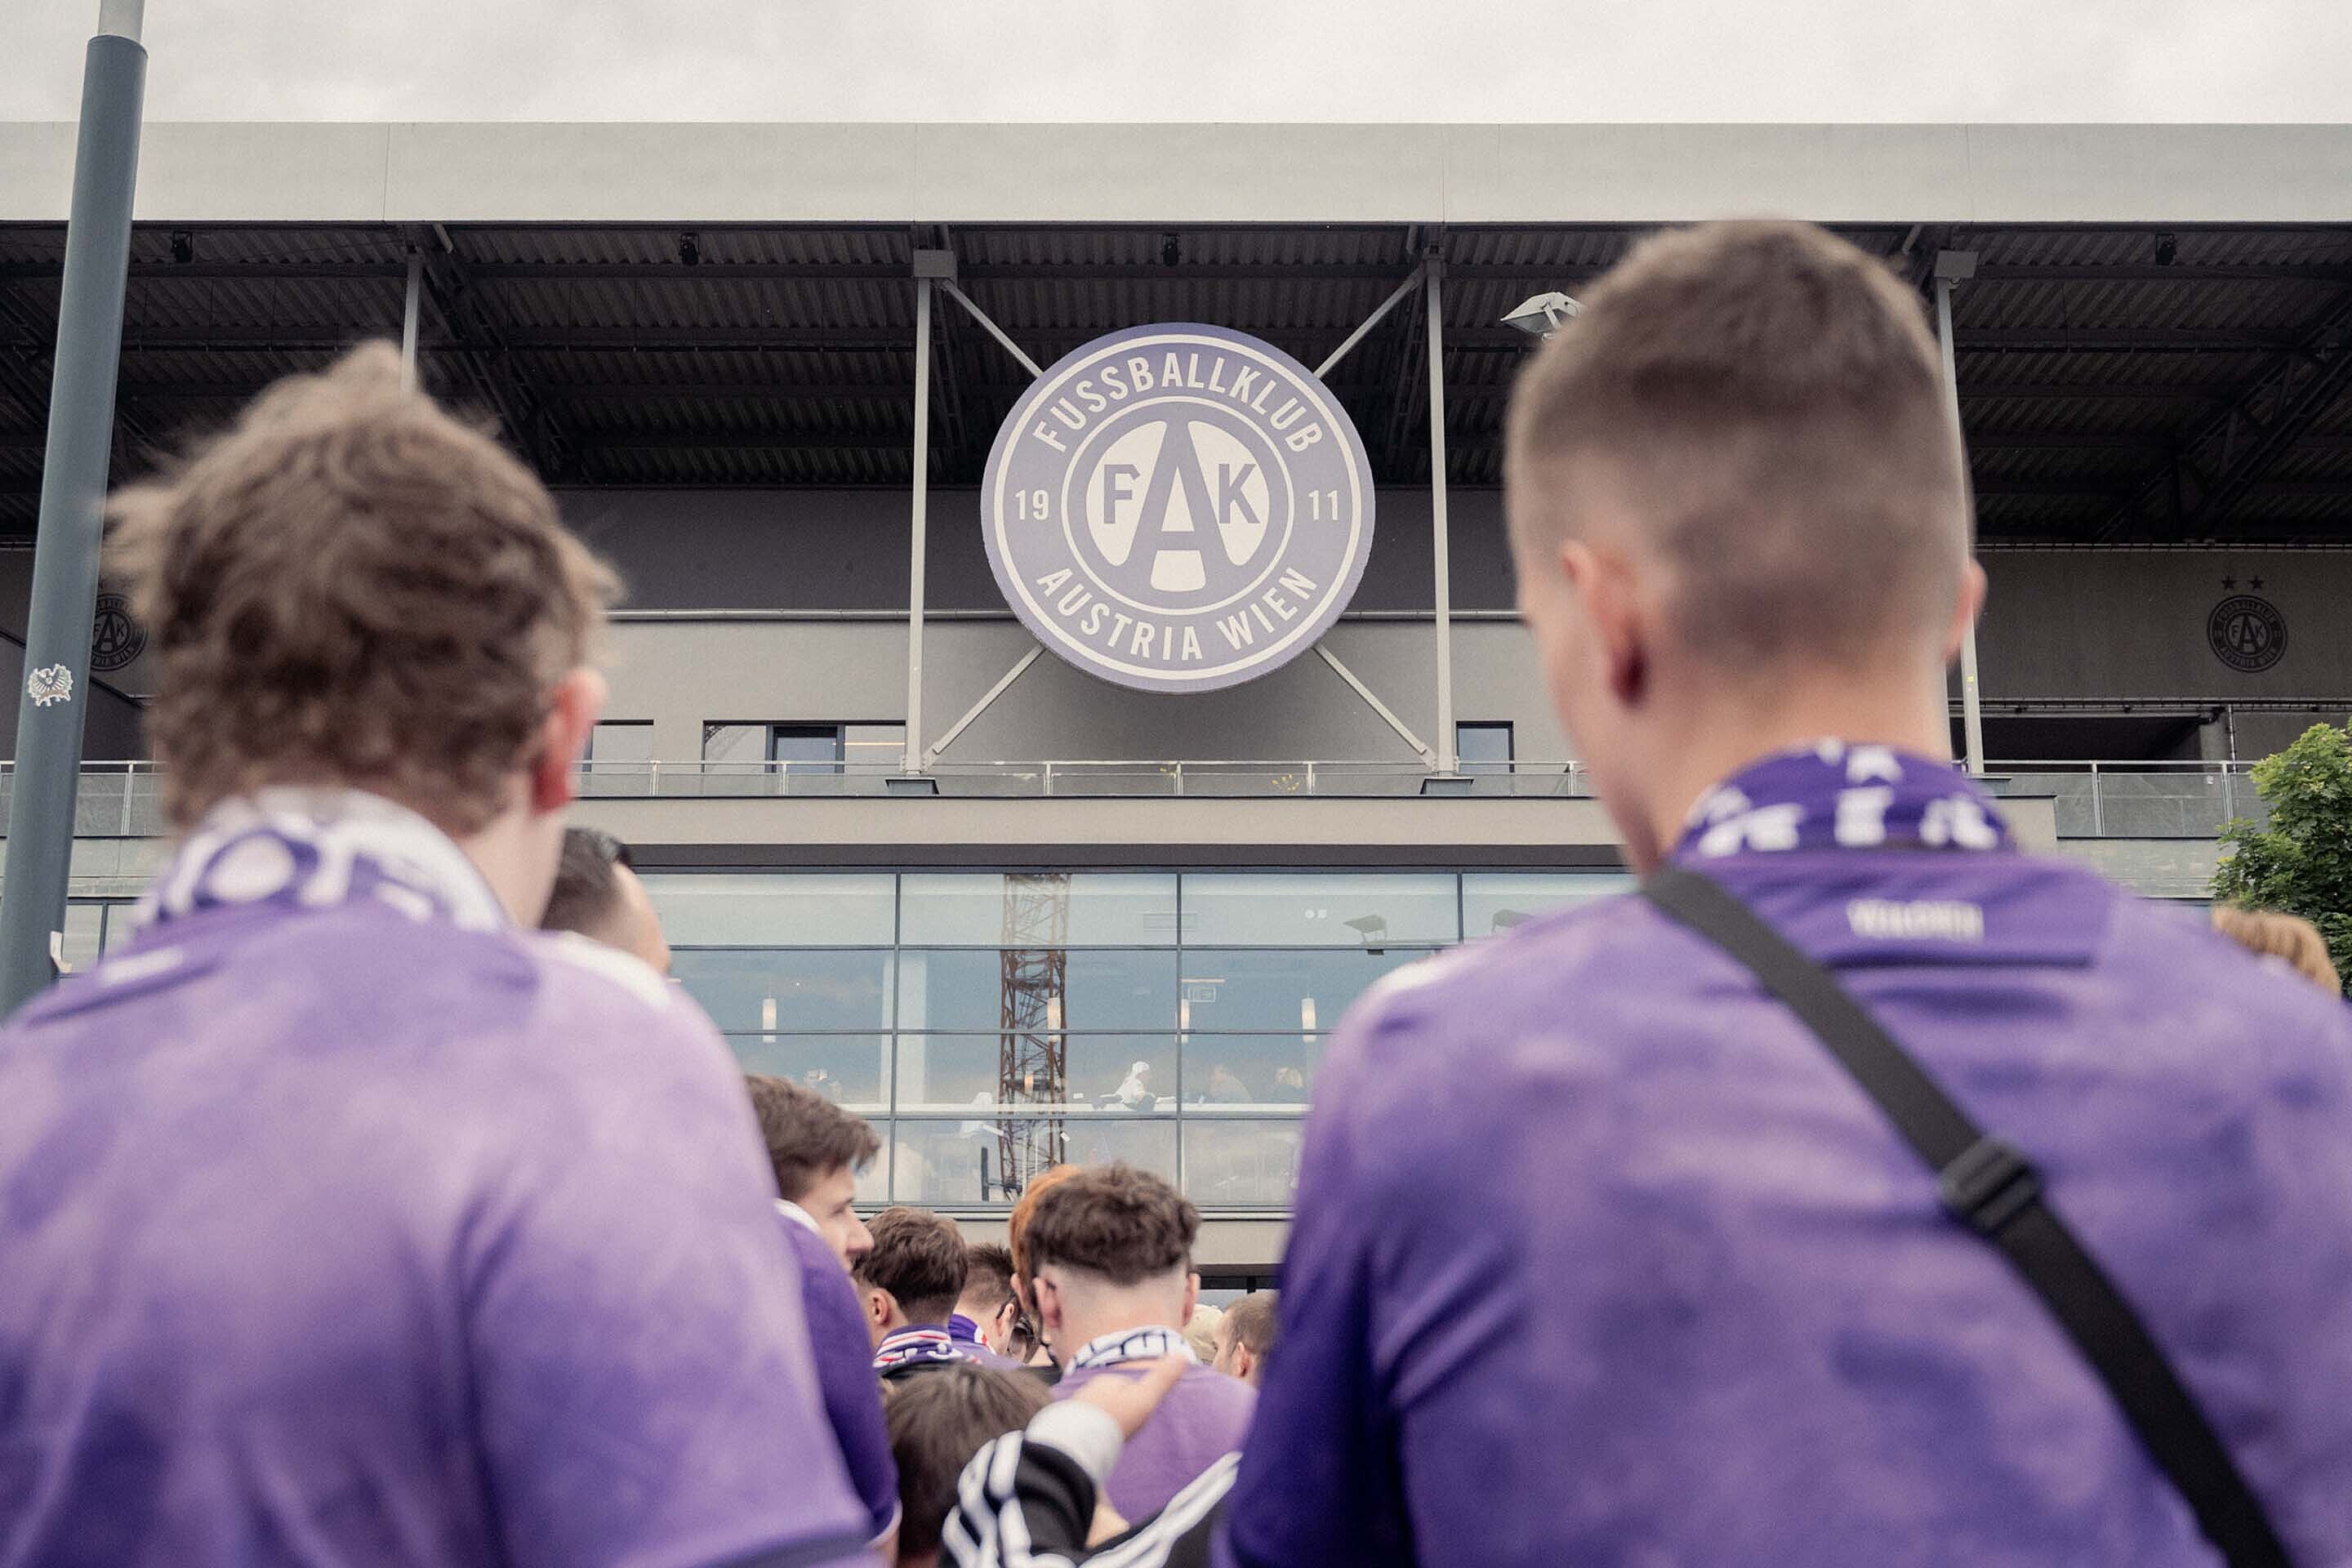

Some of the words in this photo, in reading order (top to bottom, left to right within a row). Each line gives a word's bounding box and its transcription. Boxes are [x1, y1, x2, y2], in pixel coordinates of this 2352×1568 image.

[1032, 351, 1325, 453] FUSSBALLKLUB
[1015, 488, 1050, 522] 19
[1102, 418, 1261, 588] FAK
[1308, 488, 1339, 522] 11
[1036, 567, 1204, 662] AUSTRIA
[1215, 565, 1319, 652] WIEN
